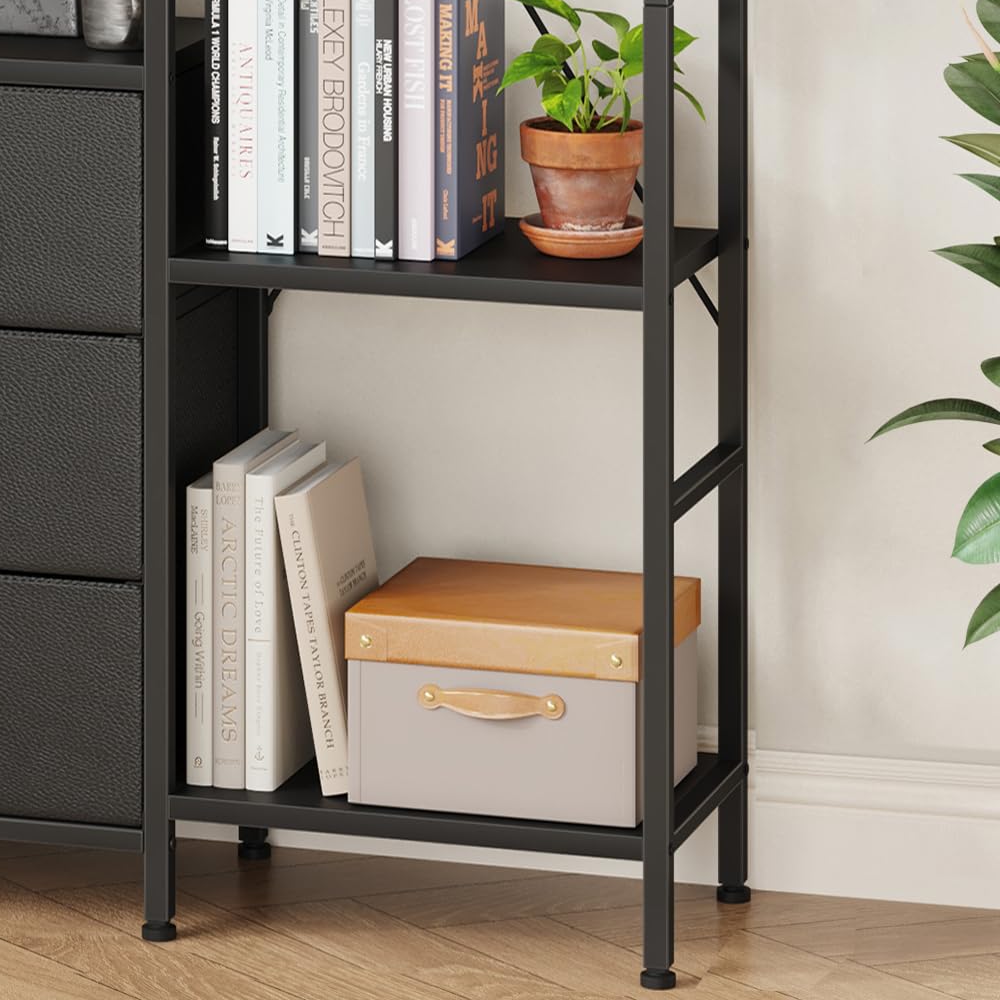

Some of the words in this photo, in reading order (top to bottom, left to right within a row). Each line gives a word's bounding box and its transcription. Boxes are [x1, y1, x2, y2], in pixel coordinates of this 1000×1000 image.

[264, 28, 275, 61] McLeod
[277, 22, 287, 30] in
[439, 3, 453, 72] MAKING
[211, 37, 221, 71] WORLD
[277, 31, 287, 88] Contemporary
[375, 39, 383, 64] HILARY
[383, 39, 393, 62] NEW
[211, 71, 221, 125] CHAMPIONS
[357, 61, 371, 118] Gardens
[375, 65, 383, 95] FRENCH
[383, 62, 393, 97] URBAN
[403, 57, 425, 110] FISH
[439, 73, 453, 93] IT
[235, 42, 254, 180] ANTIQUAIRES
[277, 89, 287, 134] Residential
[357, 119, 371, 132] in
[383, 98, 393, 143] HOUSING
[277, 135, 287, 183] Architecture
[322, 78, 345, 239] BRODOVITCH
[357, 134, 371, 183] France
[200, 508, 209, 552] SHIRLEY
[254, 496, 264, 526] The
[221, 516, 238, 620] ARCTIC
[254, 528, 264, 578] Future
[291, 529, 308, 590] CLINTON
[254, 582, 264, 598] of
[193, 611, 205, 649] Going
[254, 600, 264, 634] Love
[301, 593, 317, 635] TAPES
[193, 650, 205, 689] Within
[221, 628, 238, 744] DREAMS
[308, 637, 326, 690] TAYLOR
[317, 692, 335, 750] BRANCH
